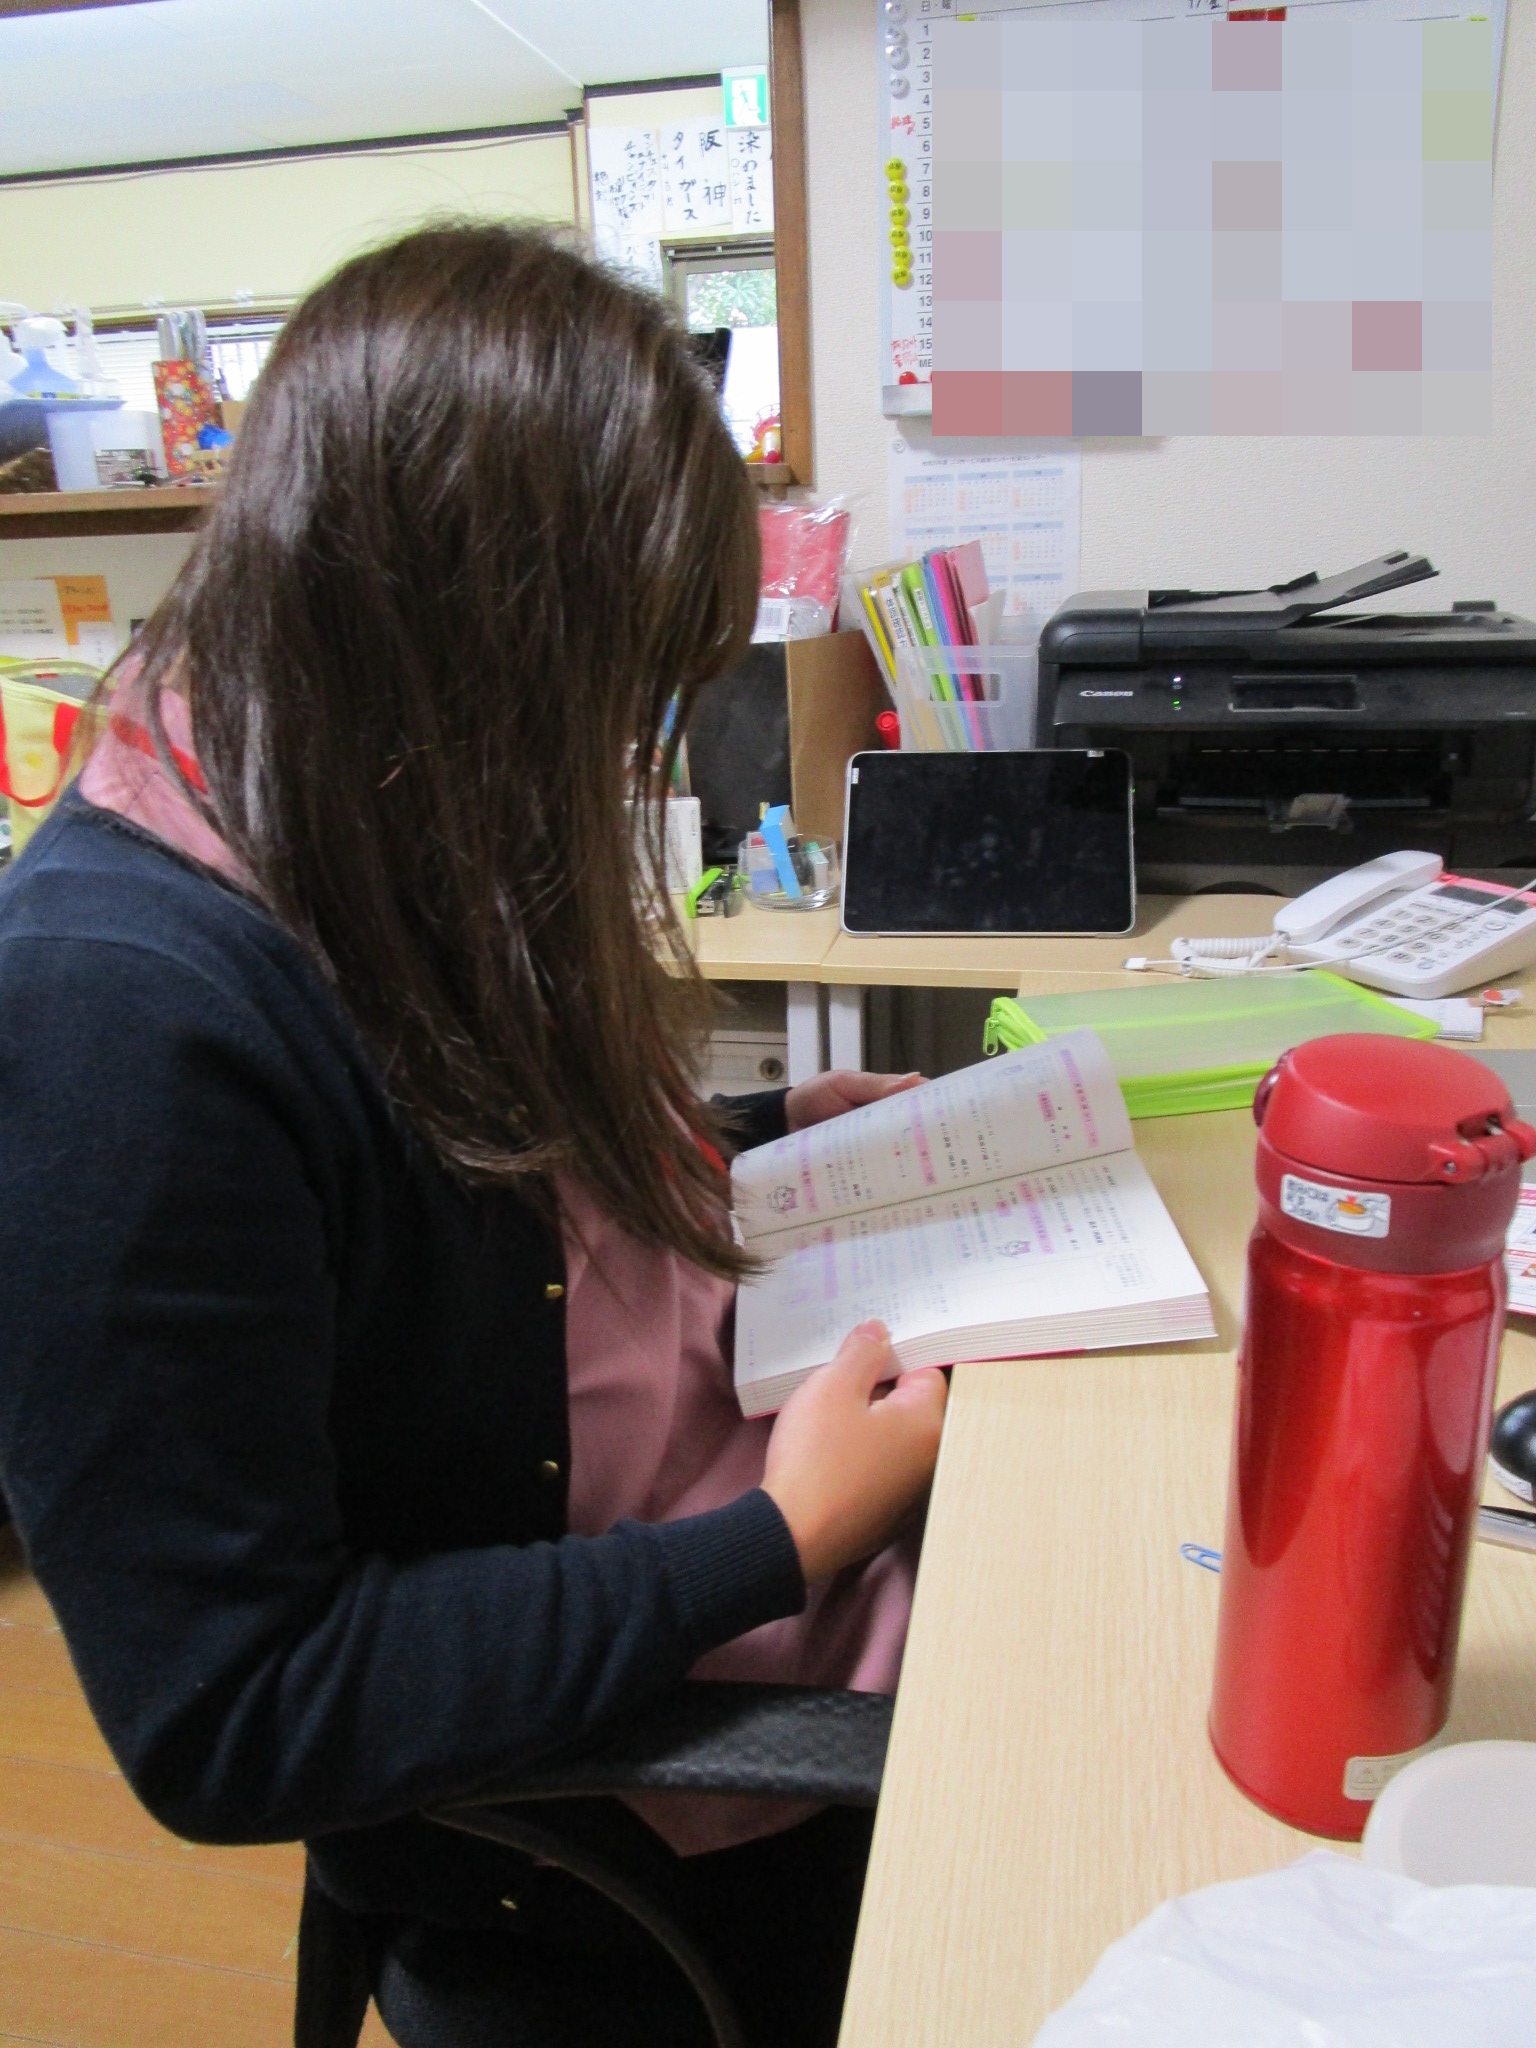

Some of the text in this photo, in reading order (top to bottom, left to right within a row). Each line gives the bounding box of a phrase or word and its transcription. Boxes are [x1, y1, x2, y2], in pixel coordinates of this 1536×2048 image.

[923, 24, 929, 36] 1
[922, 48, 930, 59] 2
[922, 71, 930, 83] 3
[922, 94, 930, 106] 4
[922, 118, 930, 130] 5
[922, 141, 930, 152] 6
[699, 129, 727, 207] 阪神
[922, 164, 930, 175] 7
[673, 131, 698, 221] タイガース
[922, 186, 930, 198] 8
[922, 209, 930, 220] 9
[919, 230, 932, 242] 10
[919, 253, 932, 264] 11
[919, 274, 932, 285] 12
[919, 296, 932, 307] 13
[919, 317, 932, 329] 14
[919, 338, 932, 350] 15
